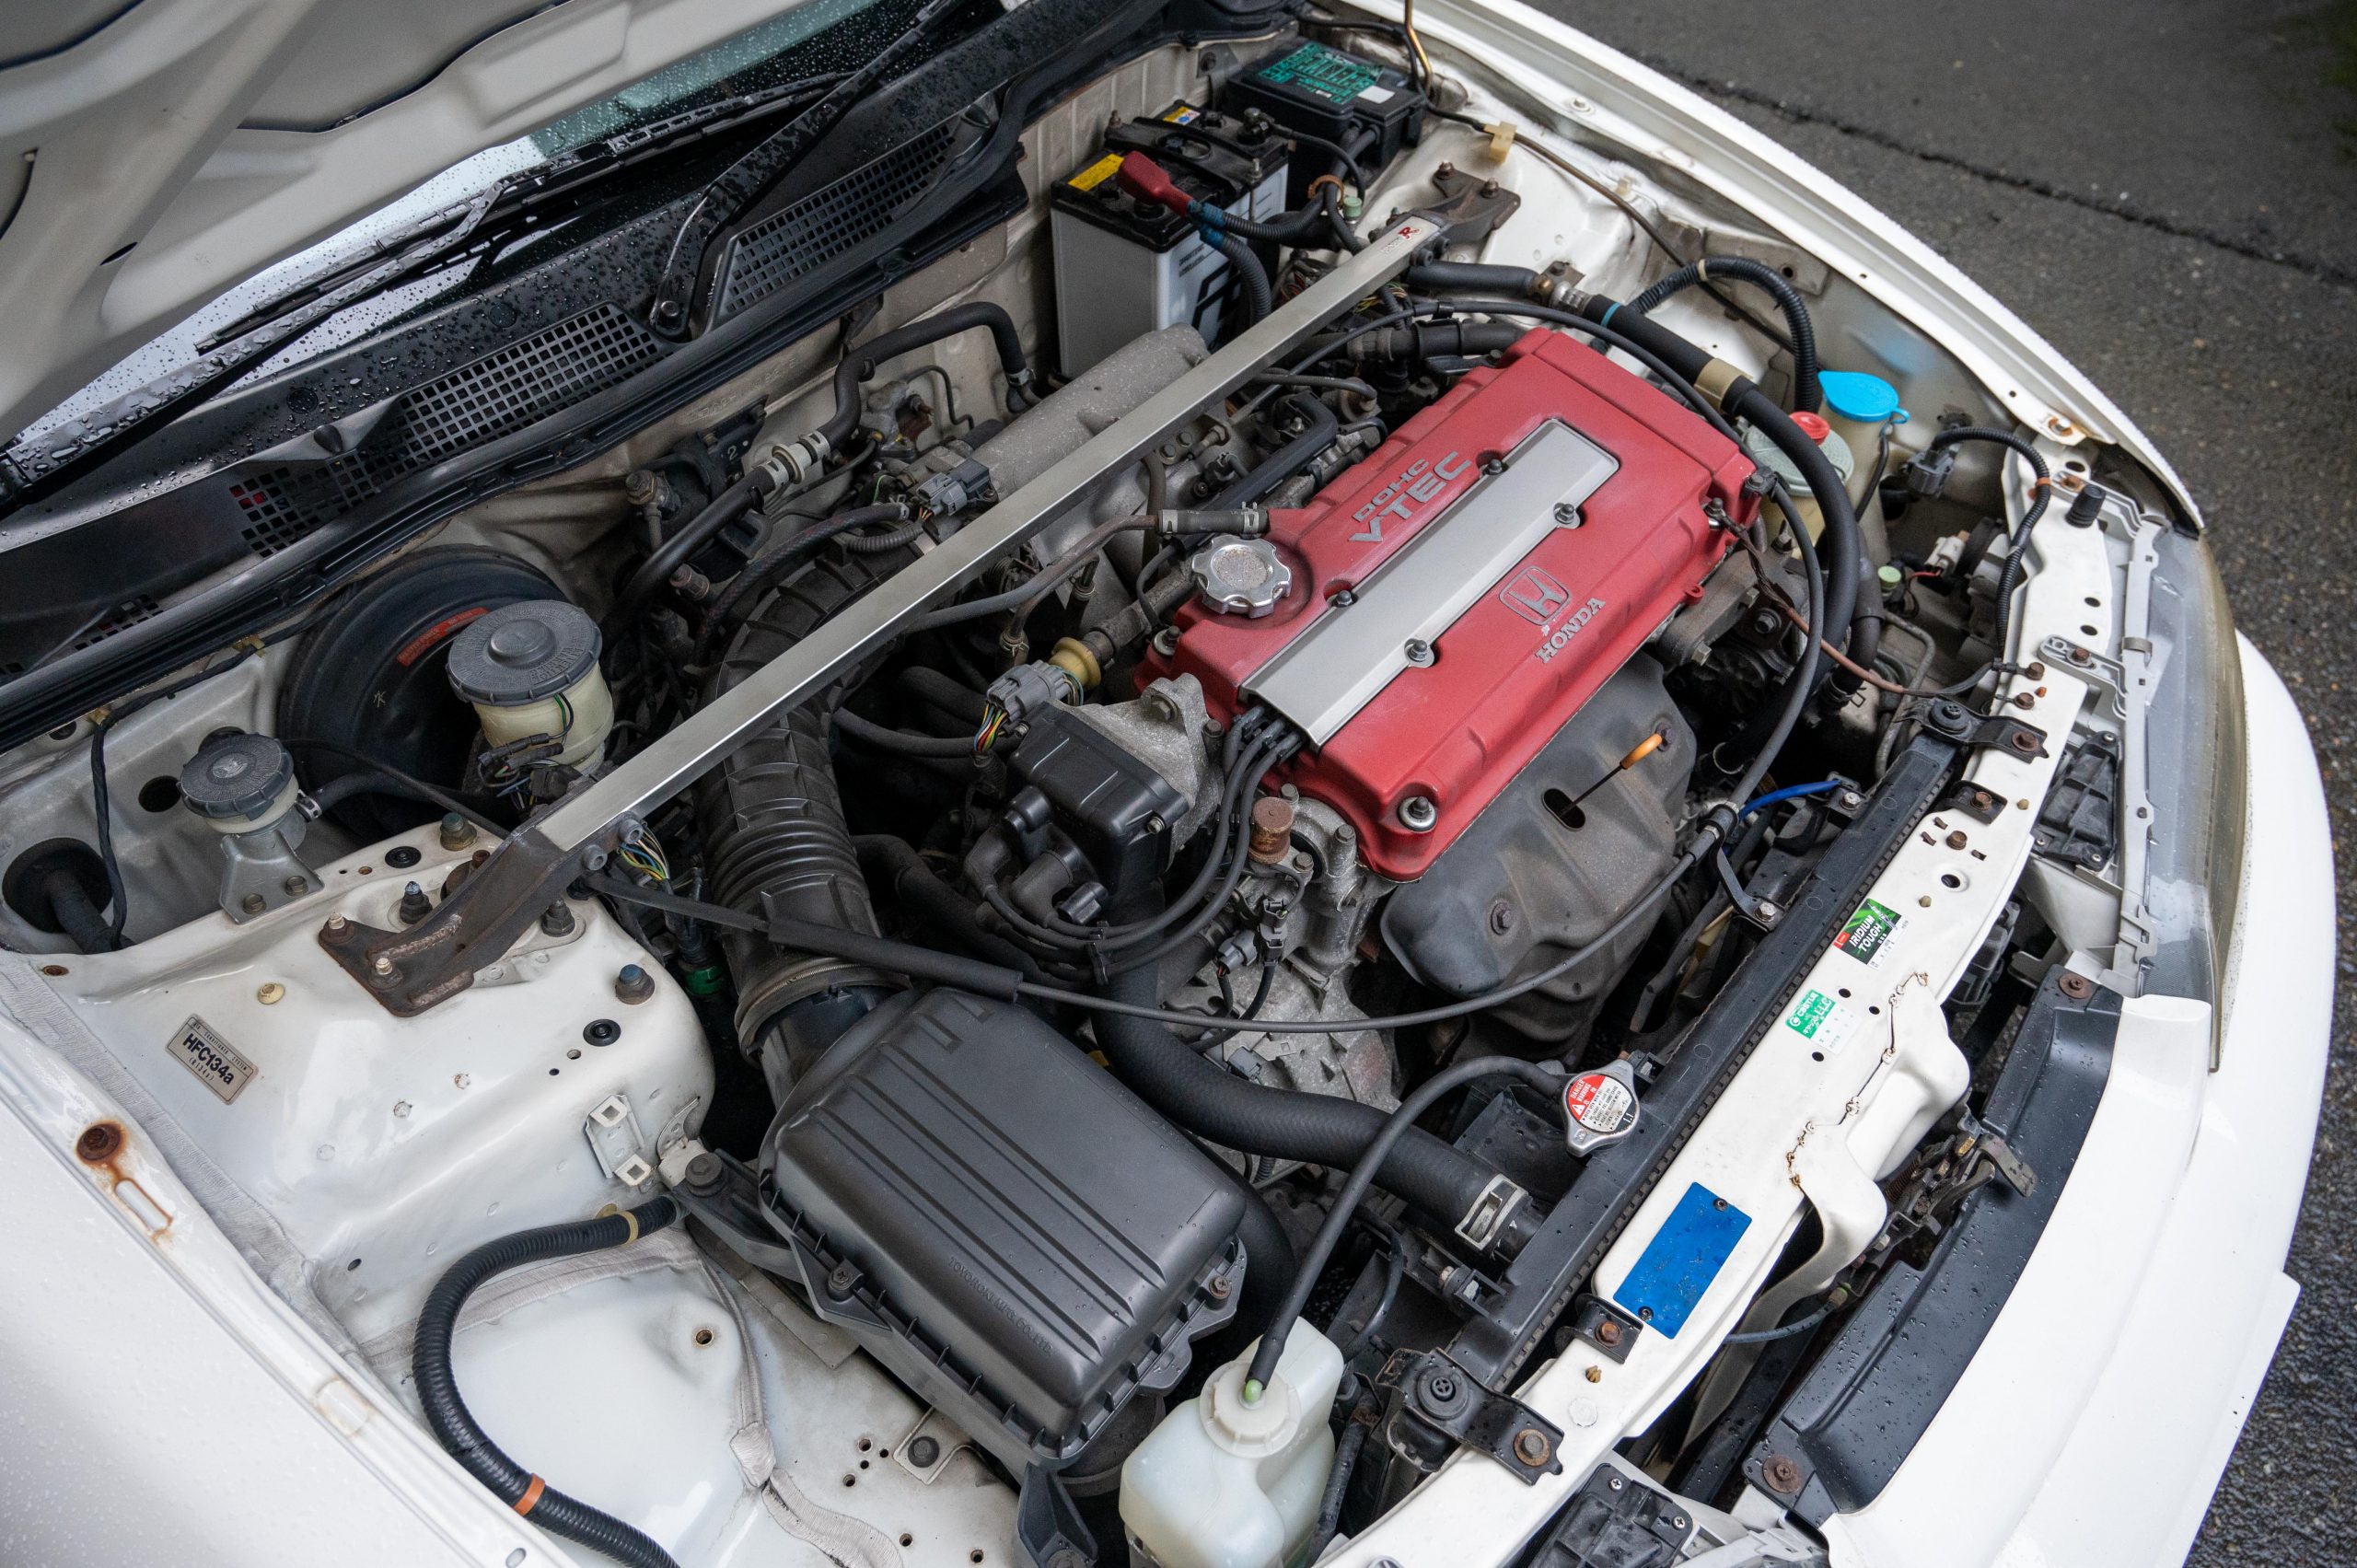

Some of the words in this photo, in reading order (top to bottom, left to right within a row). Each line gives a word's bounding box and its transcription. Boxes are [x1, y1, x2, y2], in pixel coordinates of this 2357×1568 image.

[1348, 450, 1472, 542] VTEC
[1352, 459, 1430, 523] DOHC
[1535, 598, 1607, 664] HONDA
[1849, 914, 1875, 947] IRIDIUM
[1858, 923, 1883, 952] TOUGH
[1814, 997, 1831, 1016] LLC
[182, 1033, 234, 1085] HFC134a
[1570, 1078, 1586, 1099] DANGER
[1575, 1083, 1592, 1102] WARNING
[1622, 1112, 1634, 1123] 1.1
